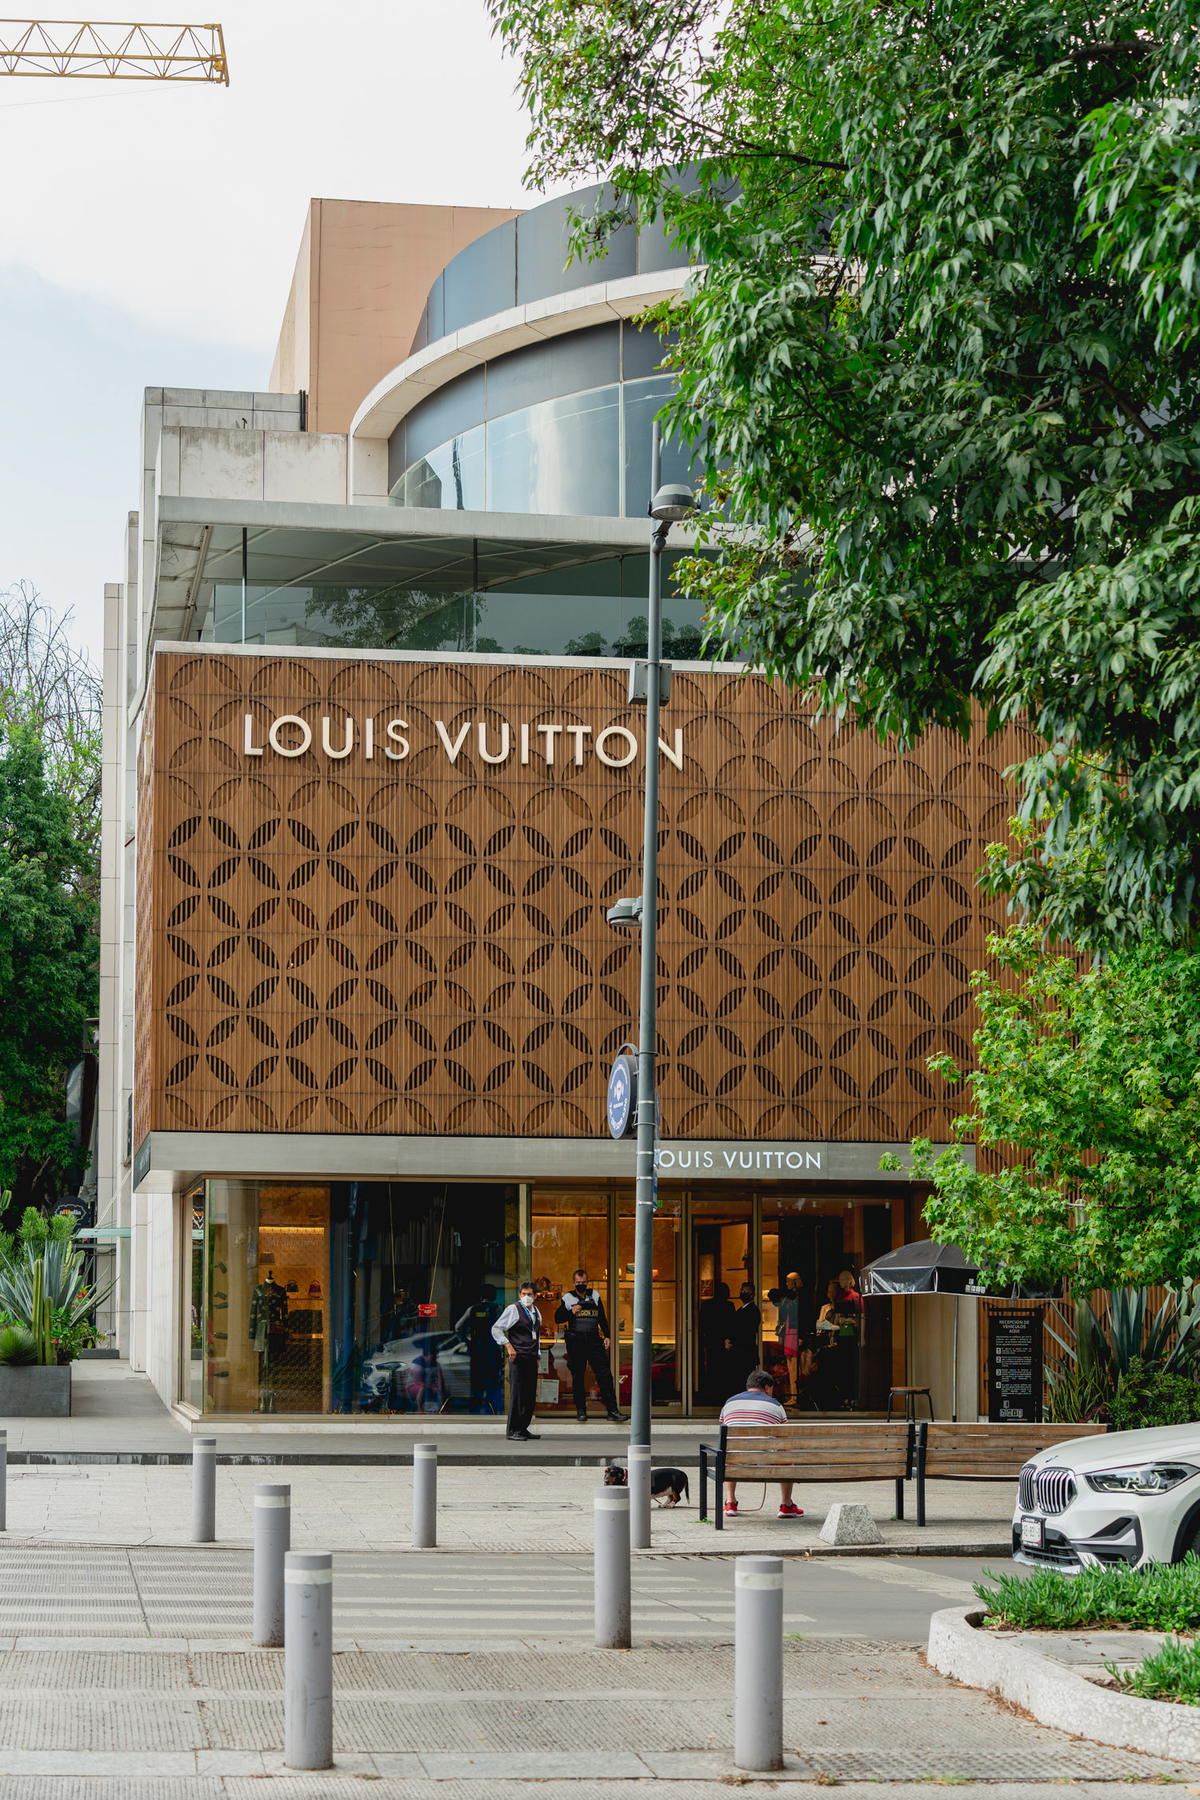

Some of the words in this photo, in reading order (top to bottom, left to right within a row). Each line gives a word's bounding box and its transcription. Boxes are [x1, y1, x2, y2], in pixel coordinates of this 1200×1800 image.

[243, 713, 411, 761] LOUIS
[435, 720, 684, 772] VUITTON
[655, 1150, 714, 1168] OUIS
[723, 1151, 822, 1169] VUITTON
